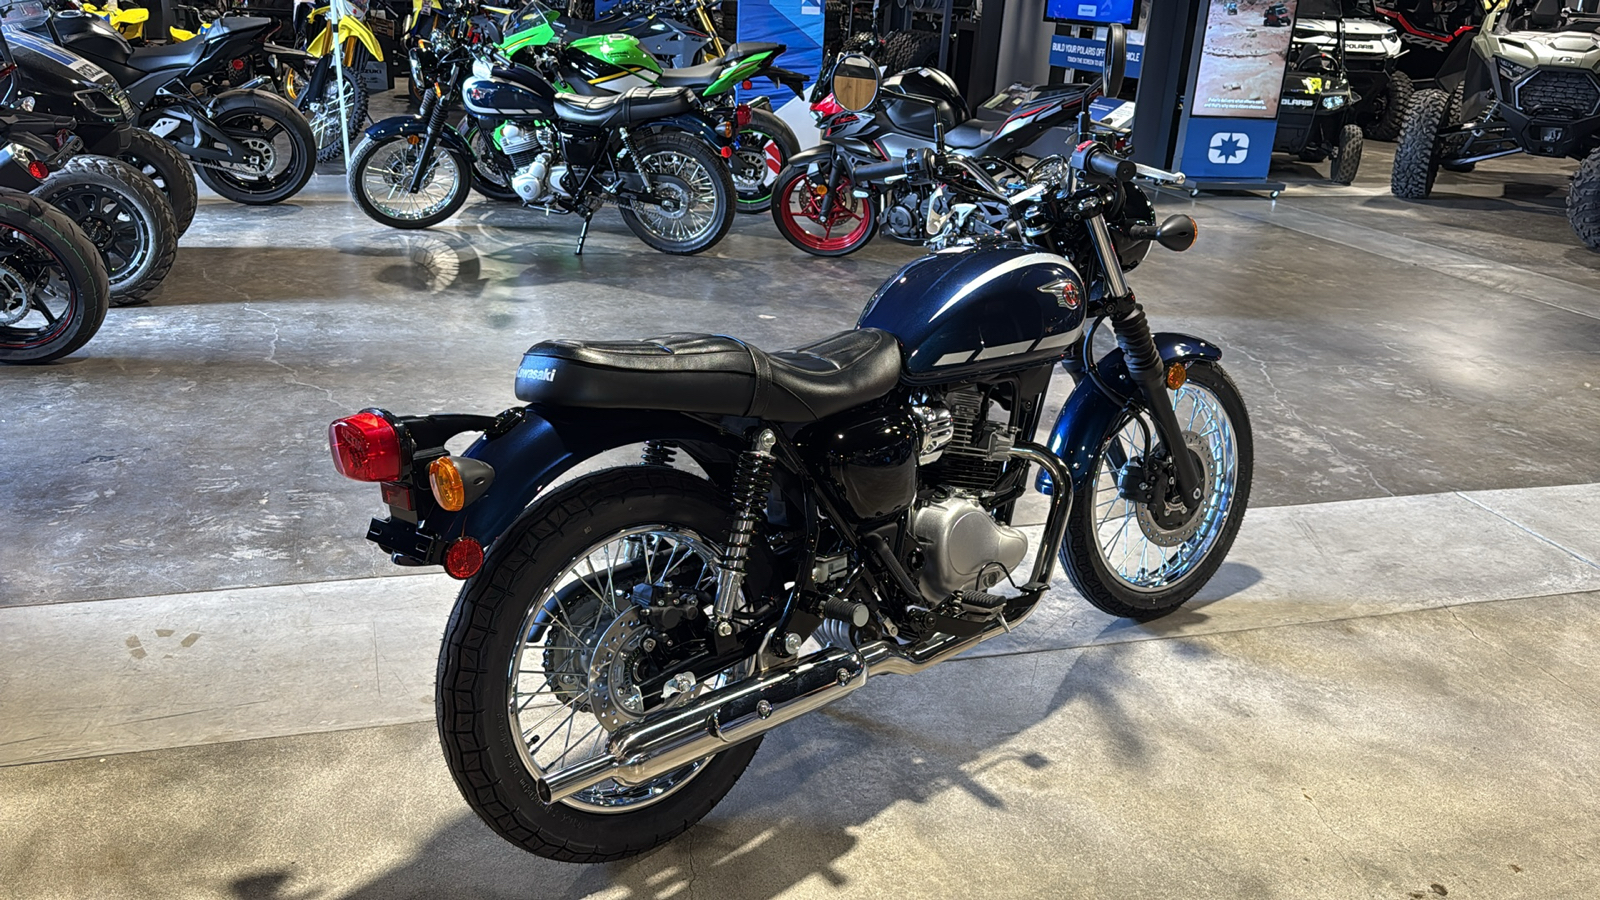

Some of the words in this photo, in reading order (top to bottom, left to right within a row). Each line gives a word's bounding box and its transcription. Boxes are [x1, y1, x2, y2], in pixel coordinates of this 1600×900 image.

[1052, 42, 1065, 52] BUILD
[1065, 44, 1077, 54] YOUR
[1077, 45, 1095, 57] POLARIS
[1126, 51, 1140, 62] HICLE
[1400, 32, 1449, 53] RZR
[1280, 98, 1314, 107] OLARIS
